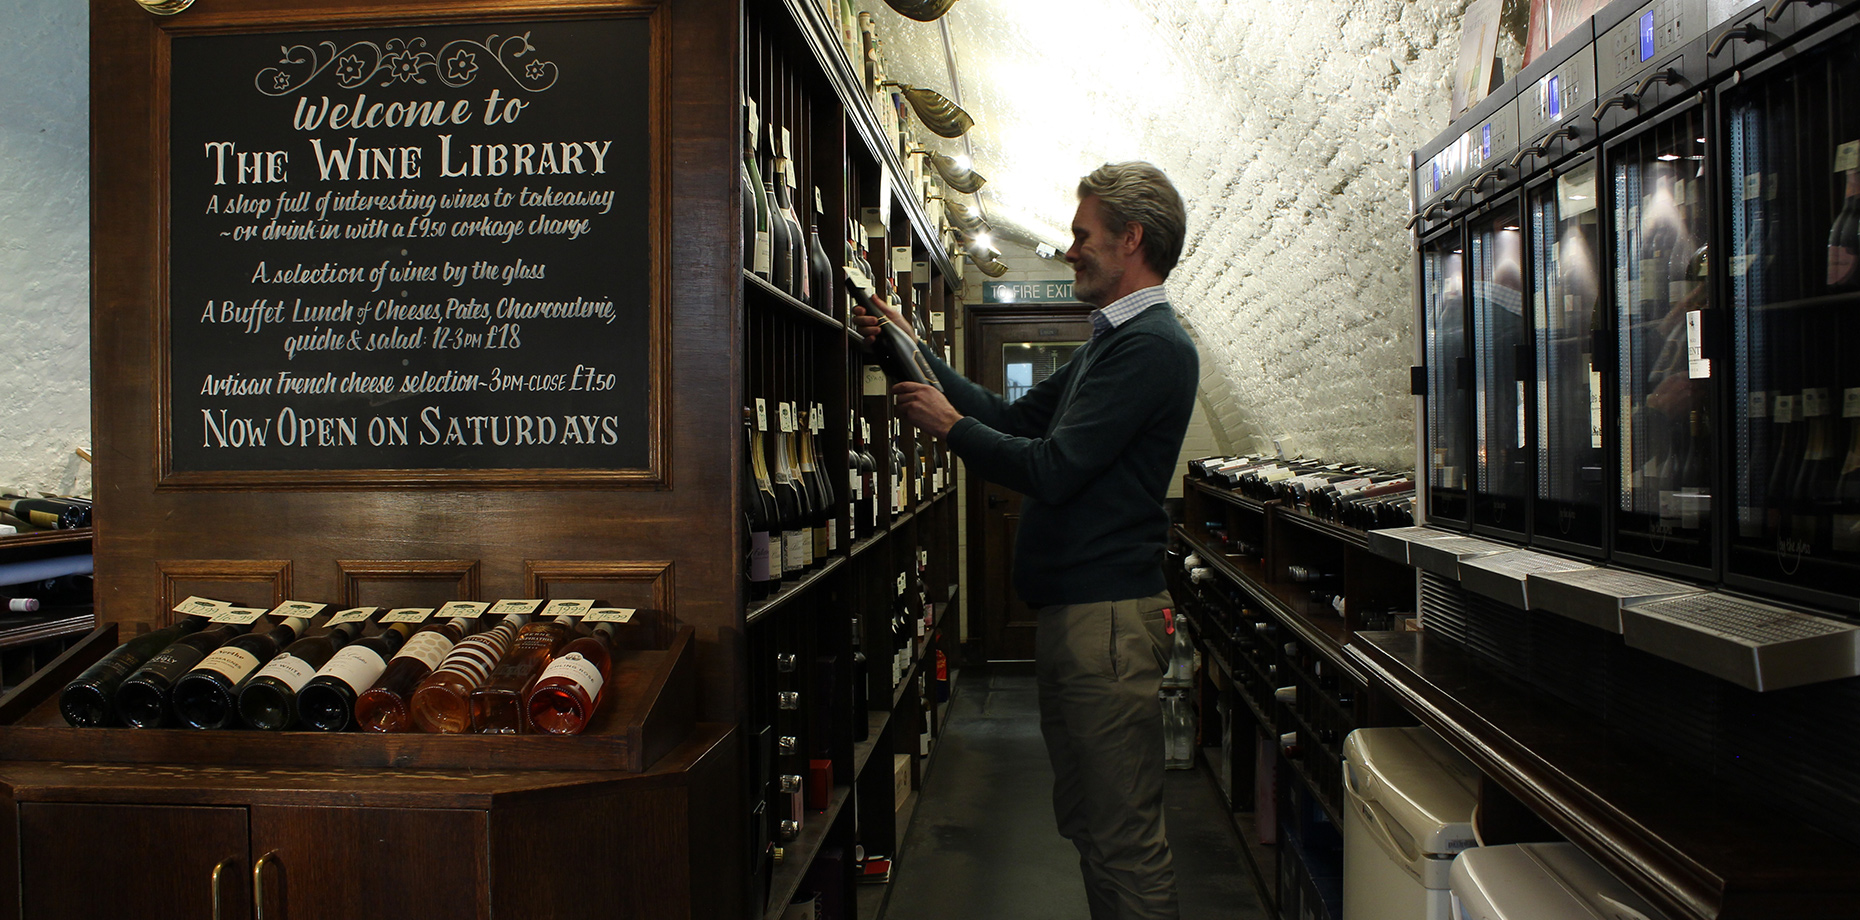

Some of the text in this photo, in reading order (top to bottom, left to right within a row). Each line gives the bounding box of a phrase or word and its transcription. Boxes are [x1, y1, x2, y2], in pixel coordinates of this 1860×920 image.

[293, 88, 530, 131] Welcome to
[204, 134, 613, 186] THE WINE LIBRARY
[205, 185, 615, 222] A shop full of interesting wines to takeaway
[344, 217, 389, 240] with
[391, 222, 405, 238] a
[451, 216, 525, 244] corkage
[528, 213, 592, 241] charge
[251, 258, 546, 293] A selection of wines by the glass
[1013, 284, 1040, 298] FIRE
[1046, 284, 1074, 298] EXIT
[200, 295, 617, 334] A Buffet Lunch of Cheeses, Pates, Charcouterie,
[284, 325, 345, 361] quiche
[346, 329, 363, 351] &
[484, 323, 521, 350] £18
[200, 372, 273, 397] Artisan
[276, 371, 338, 395] French
[339, 371, 395, 394] cheese
[568, 363, 616, 392] £7.50
[200, 405, 618, 448] NOW OPEN ON SATURDAYS
